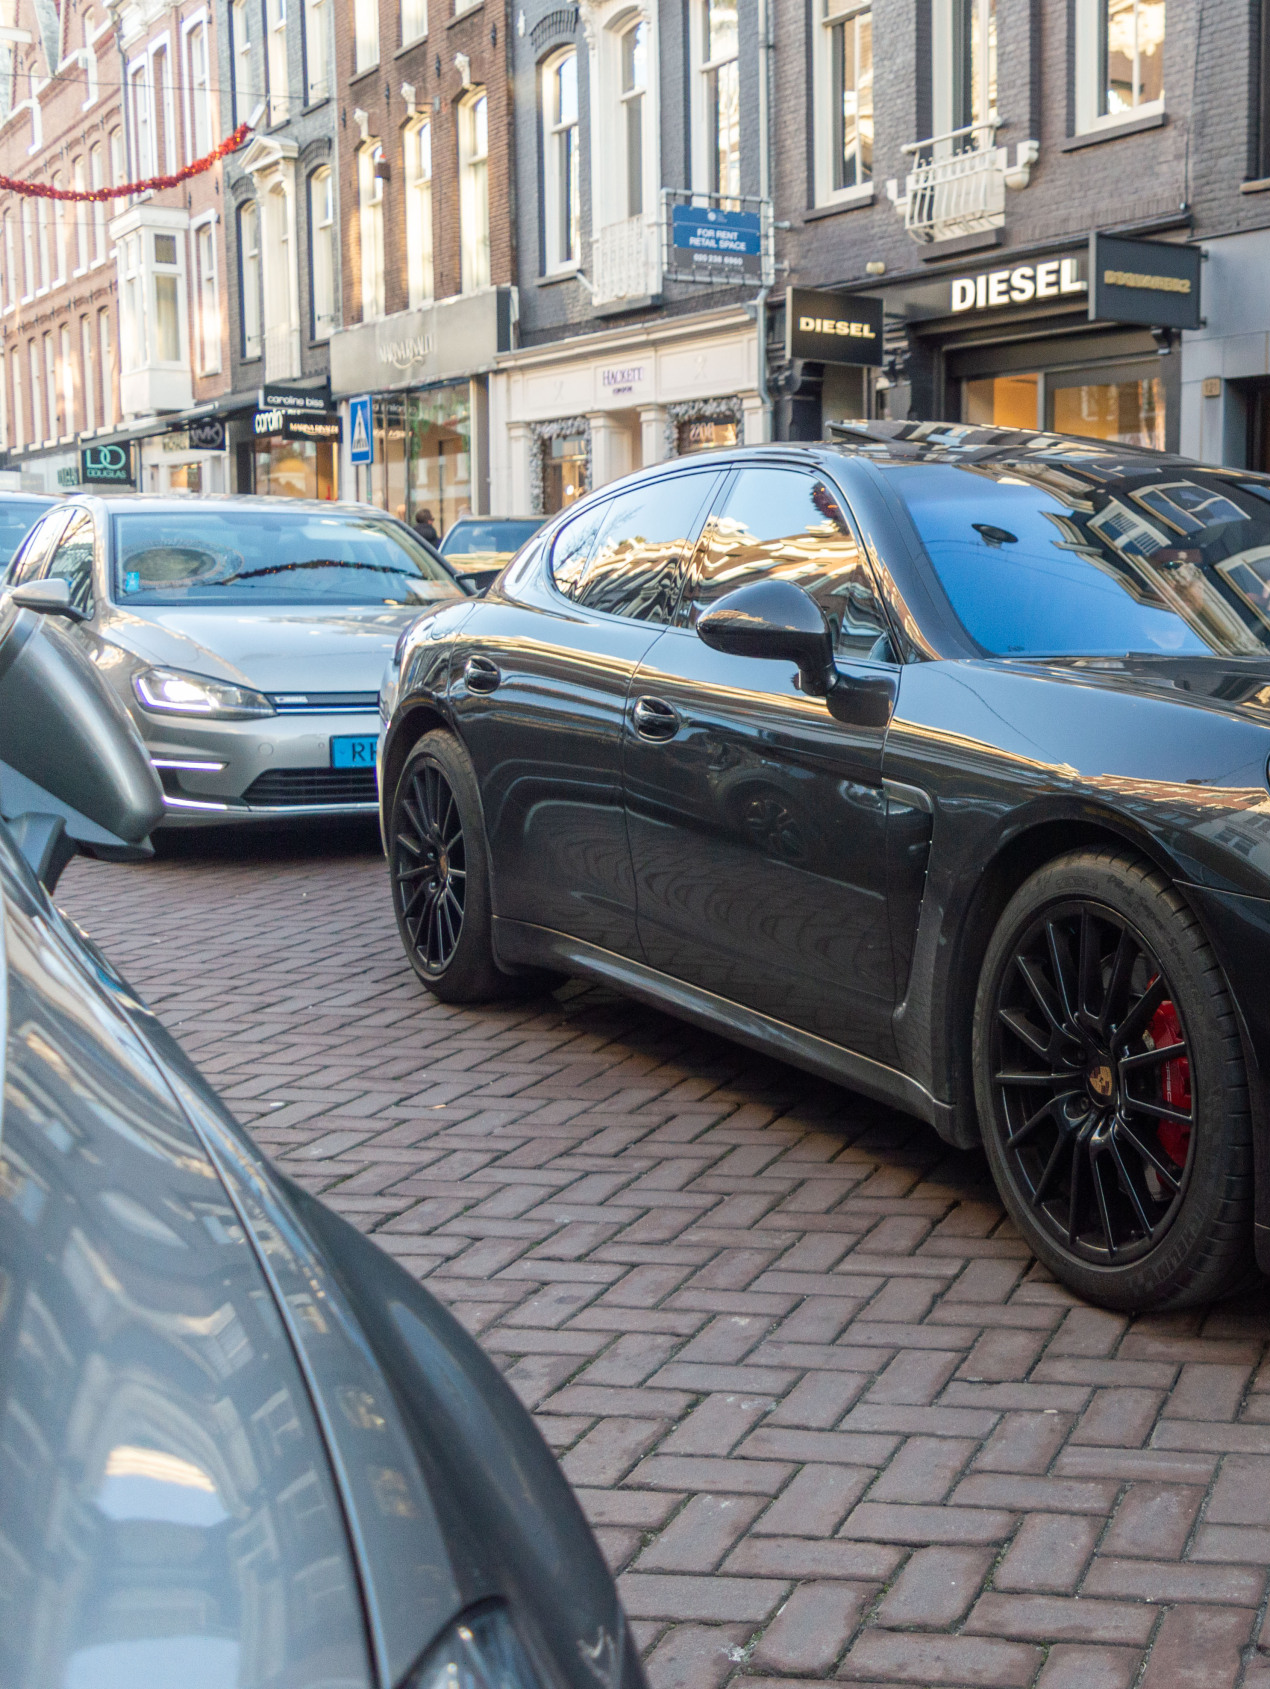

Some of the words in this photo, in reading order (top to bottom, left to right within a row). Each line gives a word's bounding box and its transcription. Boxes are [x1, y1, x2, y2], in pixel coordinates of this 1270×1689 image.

[697, 228, 715, 237] FOR
[716, 230, 738, 240] RENT
[689, 237, 717, 248] RETAIL
[719, 240, 746, 251] SPACE
[951, 258, 1087, 312] DIESEL
[799, 316, 876, 339] DIESEL
[267, 396, 304, 406] caroline
[306, 397, 324, 408] biss
[87, 470, 126, 479] DOUGLAS
